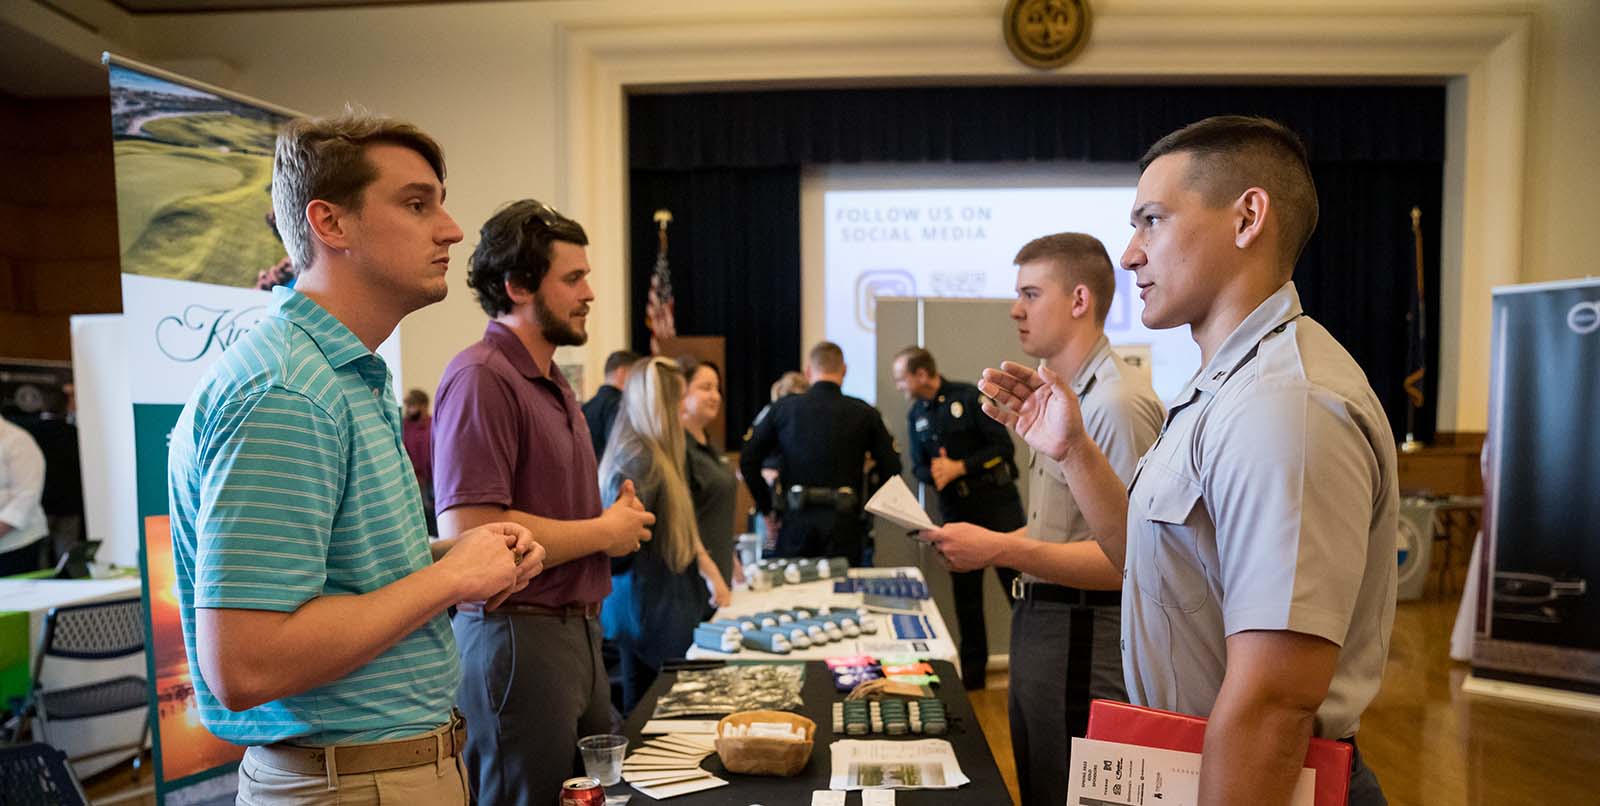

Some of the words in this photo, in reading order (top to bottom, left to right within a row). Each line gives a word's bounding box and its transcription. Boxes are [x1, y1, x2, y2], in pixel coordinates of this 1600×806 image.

[836, 207, 919, 222] FOLLOW
[928, 207, 953, 222] US
[961, 206, 992, 221] ON
[841, 226, 911, 242] SOCIAL
[922, 225, 988, 241] MEDIA
